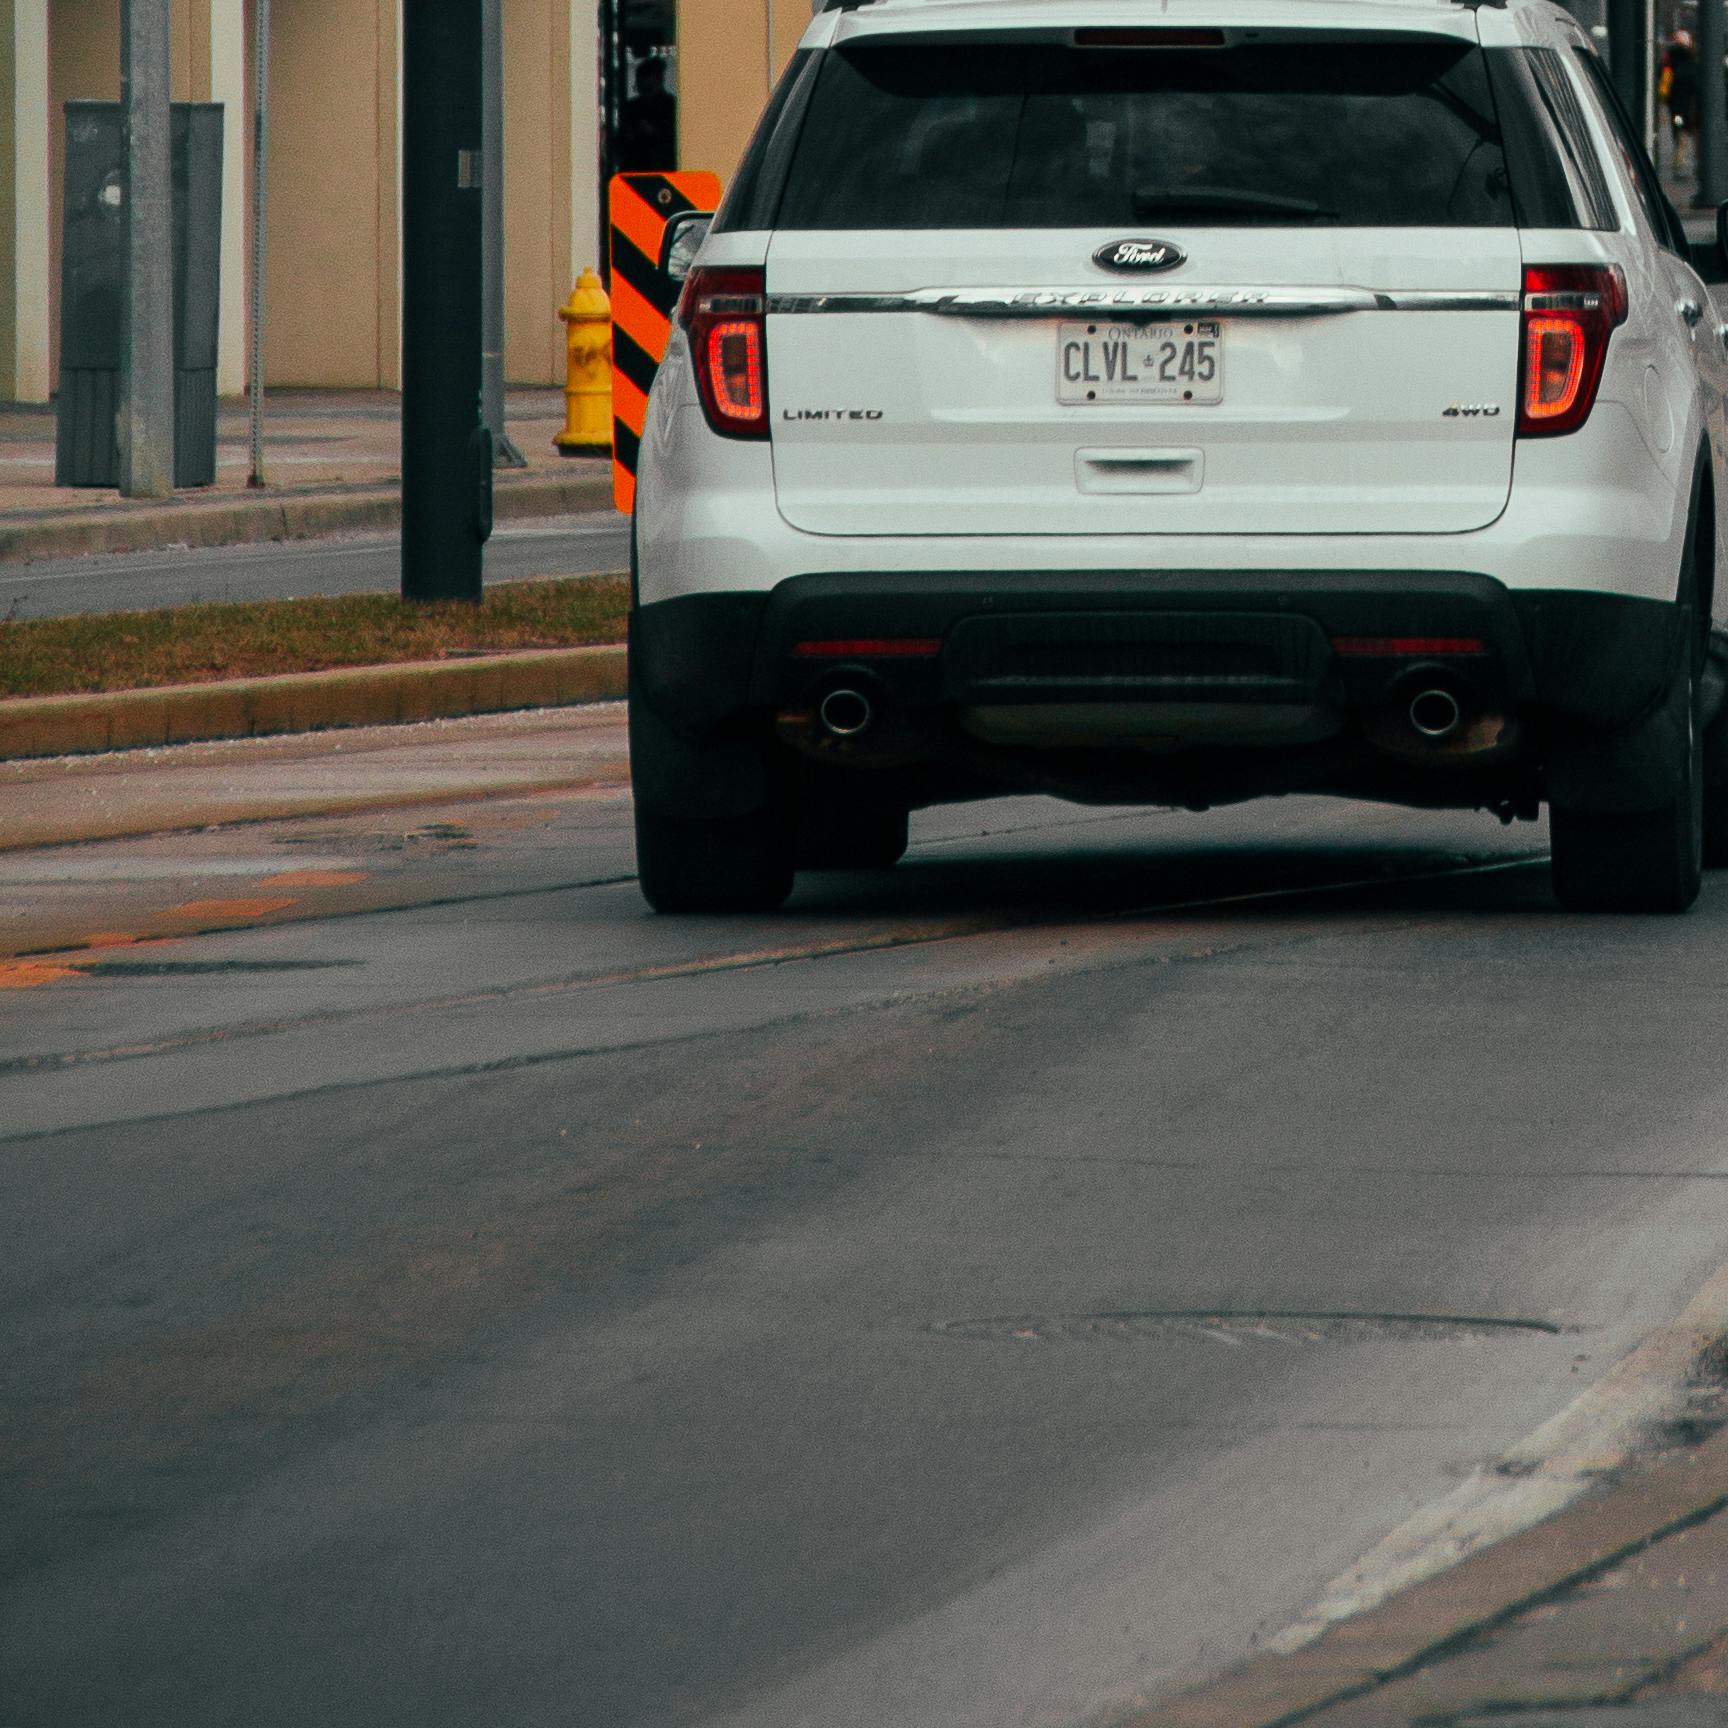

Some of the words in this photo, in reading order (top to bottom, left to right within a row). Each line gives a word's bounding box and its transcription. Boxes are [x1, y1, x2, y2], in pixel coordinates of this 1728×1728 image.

[1113, 242, 1167, 266] Ford
[1007, 291, 1271, 306] EXPLORER
[1107, 326, 1174, 340] ONTARIO
[1063, 340, 1139, 382] CLVL
[1159, 340, 1216, 382] 245
[782, 408, 884, 421] LIMITED
[1441, 404, 1501, 418] 4WD
